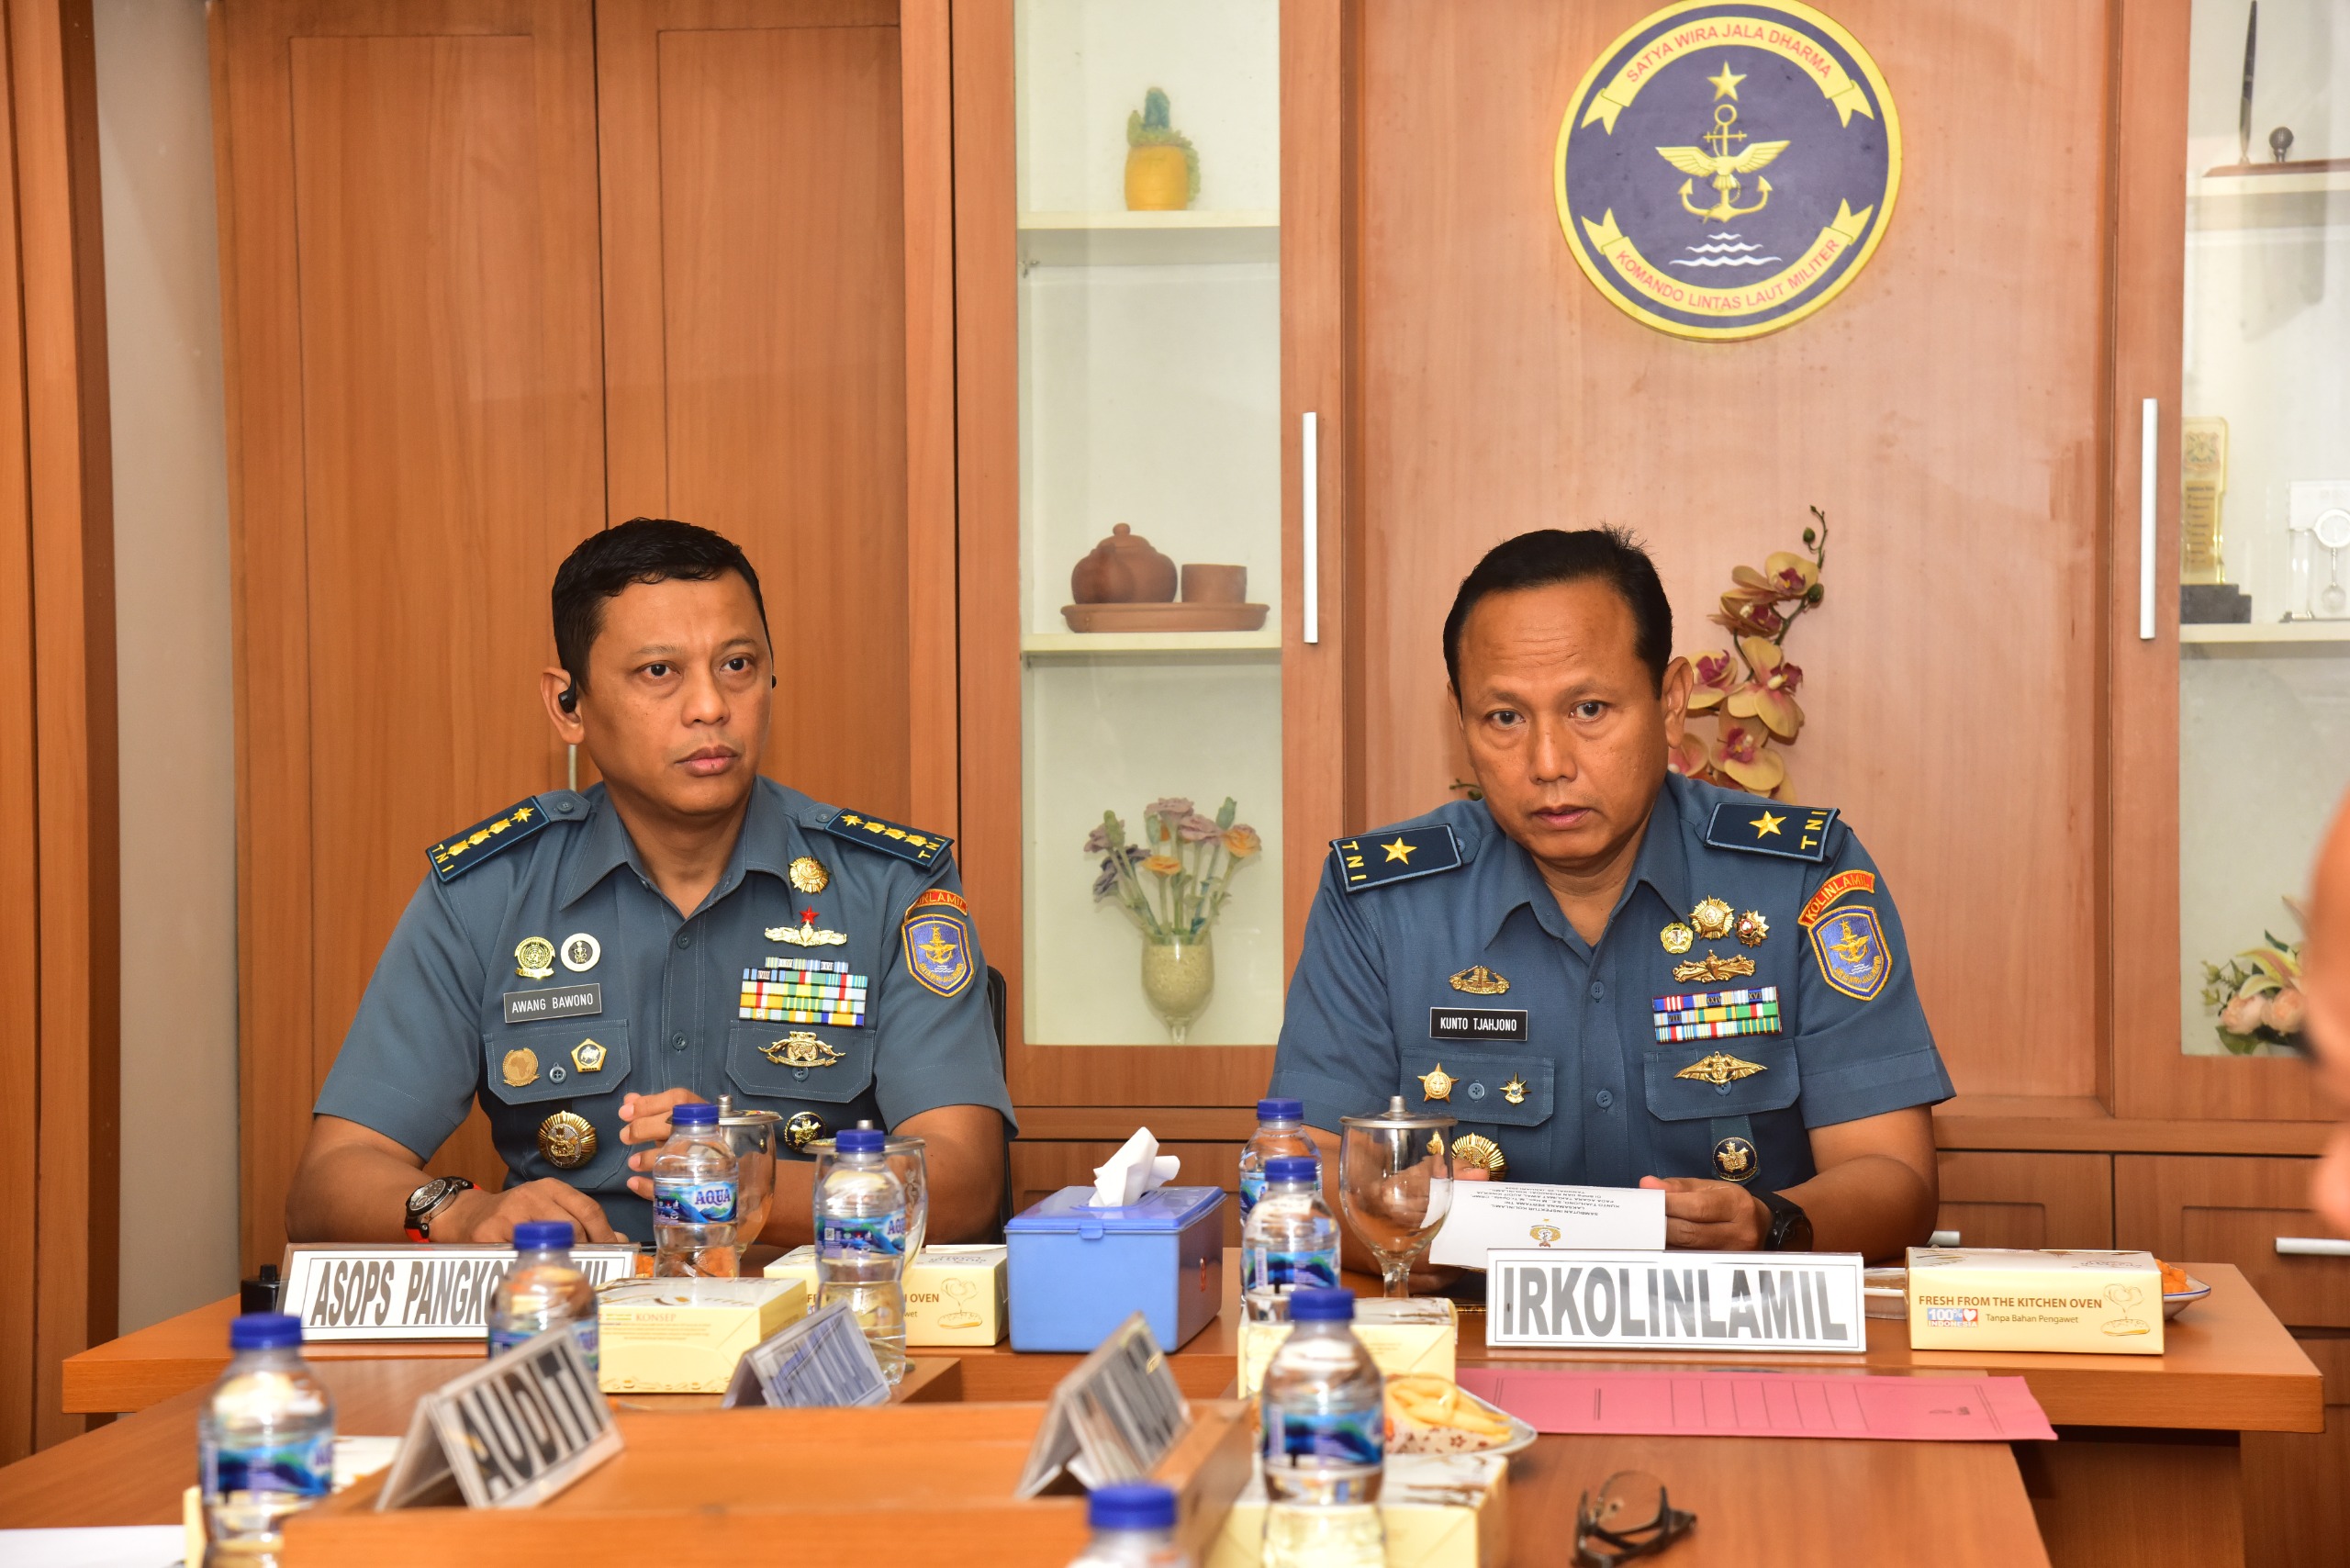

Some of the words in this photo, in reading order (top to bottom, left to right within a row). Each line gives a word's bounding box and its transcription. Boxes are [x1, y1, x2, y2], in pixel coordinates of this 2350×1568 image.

[1626, 42, 1673, 84] SATYA
[1674, 26, 1719, 50] WIRA
[1722, 24, 1764, 40] JALA
[1768, 28, 1832, 79] DHARMA
[1616, 250, 1684, 303] KOMANDO
[1688, 293, 1741, 310] LINTAS
[1746, 283, 1785, 308] LAUT
[1786, 239, 1840, 290] MILITER
[1800, 811, 1829, 850] TNI
[431, 844, 454, 873] TNI
[1342, 841, 1367, 881] TNI
[1805, 874, 1870, 922] KOLINLAMIL
[511, 998, 546, 1014] AWANG
[552, 993, 593, 1009] BAWONO
[1440, 1017, 1469, 1031] KUNTO
[1473, 1018, 1517, 1031] TJAHJONO
[695, 1189, 732, 1206] AQUA
[310, 1260, 395, 1326] ASOPS
[911, 1294, 939, 1303] OVEN
[1503, 1266, 1849, 1341] IRKOLINLAMIL
[1919, 1295, 1954, 1305] FRESH
[1957, 1296, 1991, 1306] FROM
[1993, 1297, 2015, 1307] THE
[2018, 1297, 2066, 1308] KITCHEN
[2069, 1298, 2102, 1309] OVEN
[635, 1313, 677, 1322] KONSEP
[1929, 1308, 1964, 1321] 100%
[1986, 1314, 2010, 1324] Tanpa
[2012, 1314, 2037, 1323] Bahan
[2038, 1315, 2078, 1325] Pengawet
